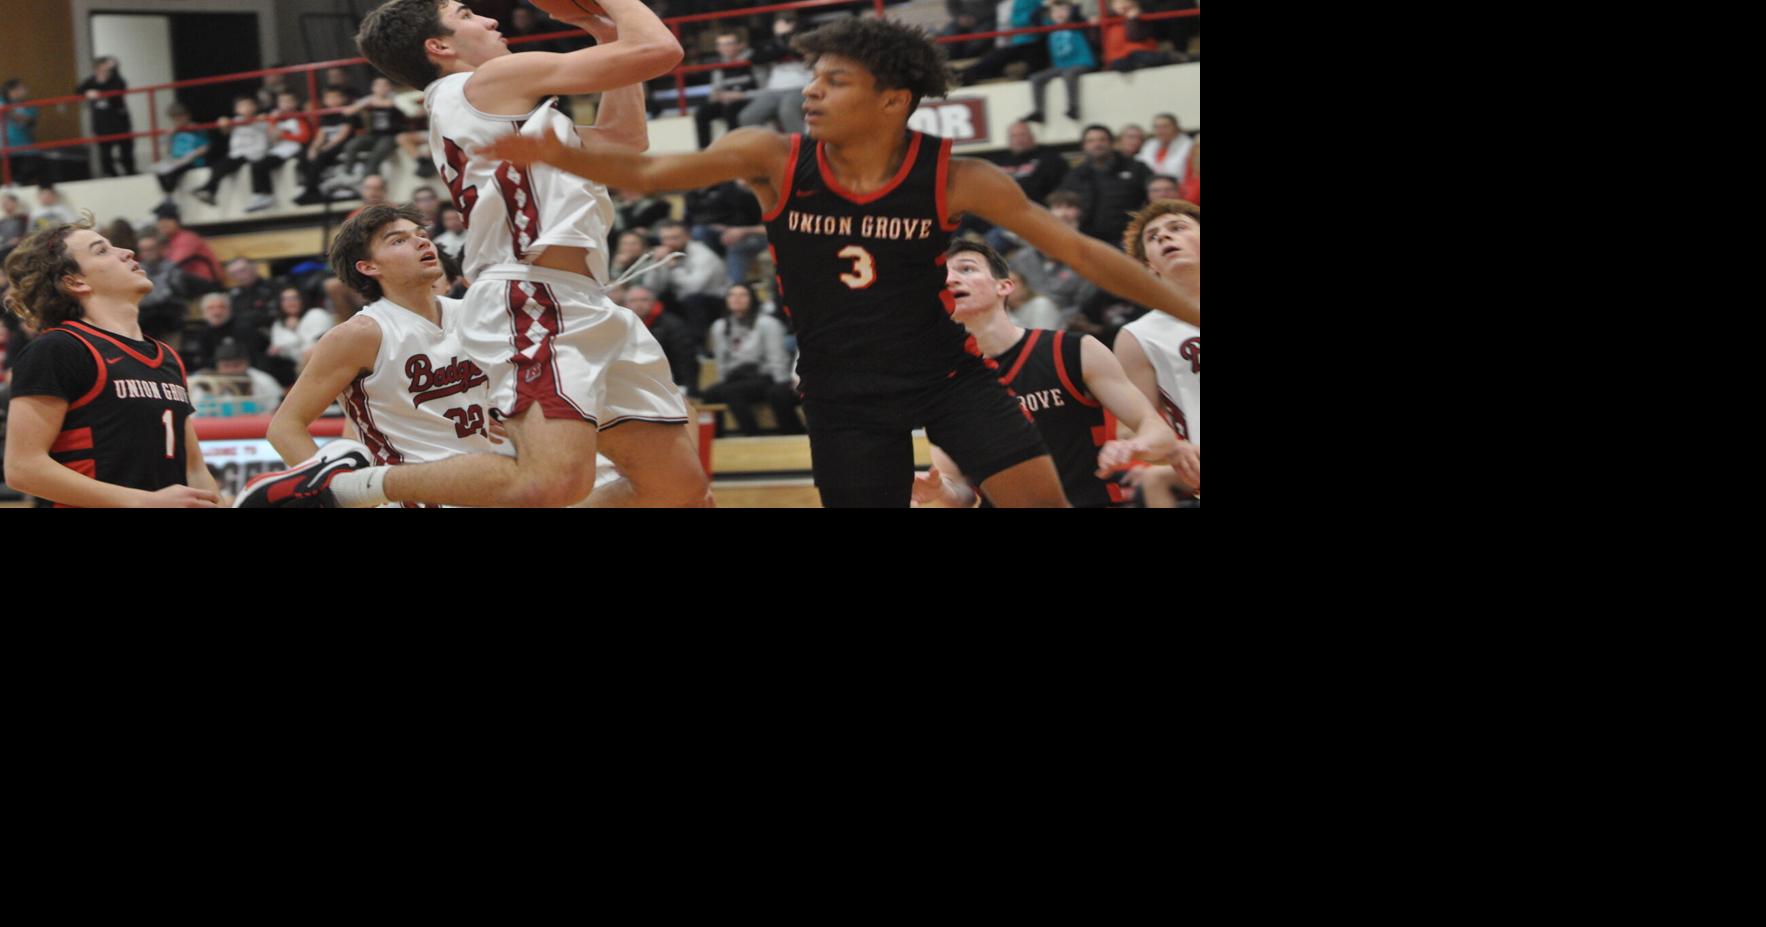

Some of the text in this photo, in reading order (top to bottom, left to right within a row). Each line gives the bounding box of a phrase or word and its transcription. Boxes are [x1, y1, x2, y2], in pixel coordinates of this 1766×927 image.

[788, 210, 933, 240] UNION GROVE
[837, 244, 877, 290] 3
[113, 379, 162, 399] UNION
[405, 353, 483, 393] Badg
[161, 408, 175, 458] 1
[443, 404, 488, 438] 22
